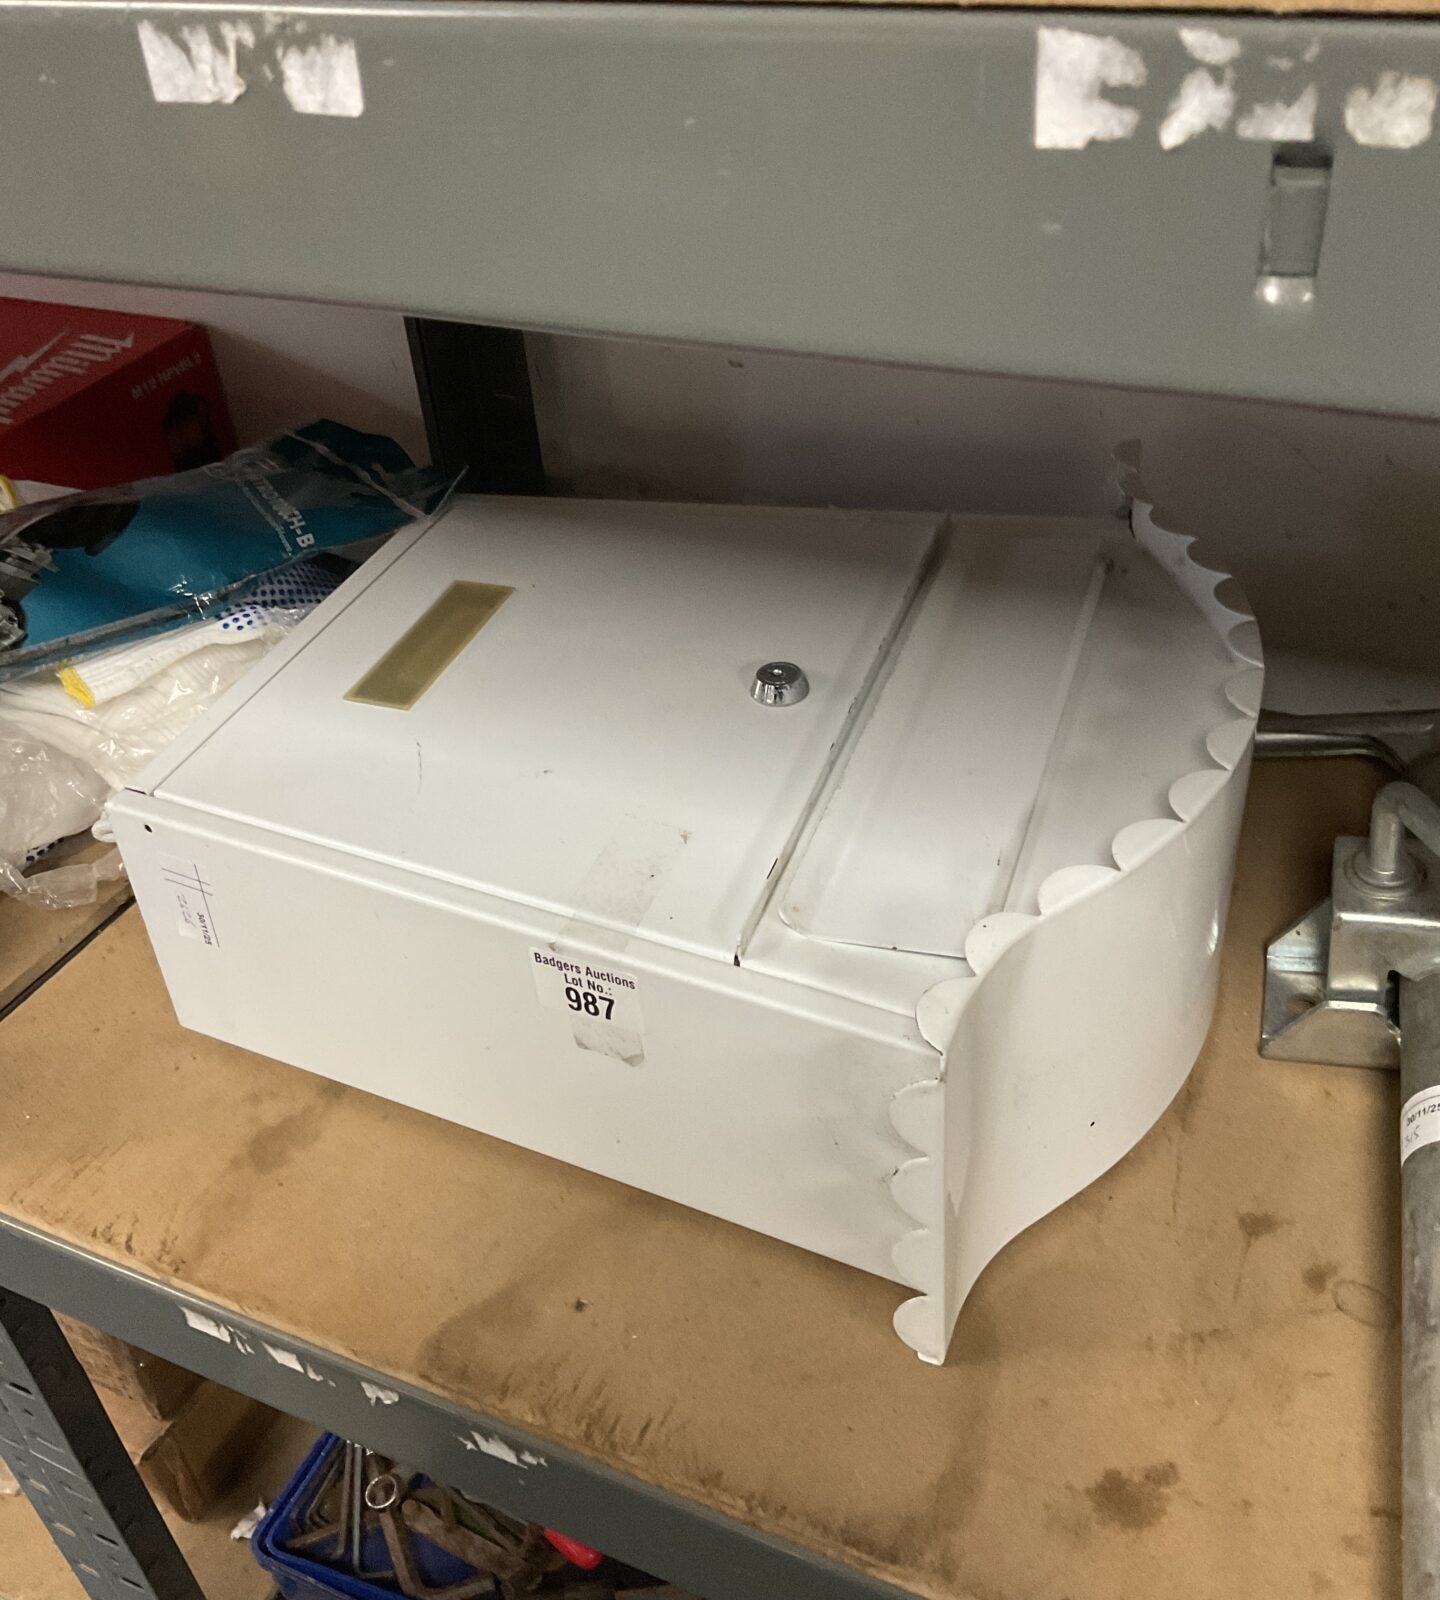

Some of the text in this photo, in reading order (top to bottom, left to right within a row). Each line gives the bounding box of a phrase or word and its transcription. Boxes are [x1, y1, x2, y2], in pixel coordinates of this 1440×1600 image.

[534, 952, 636, 990] Badgers Auctions
[564, 973, 613, 996] Lot No.:
[565, 986, 615, 1021] 987
